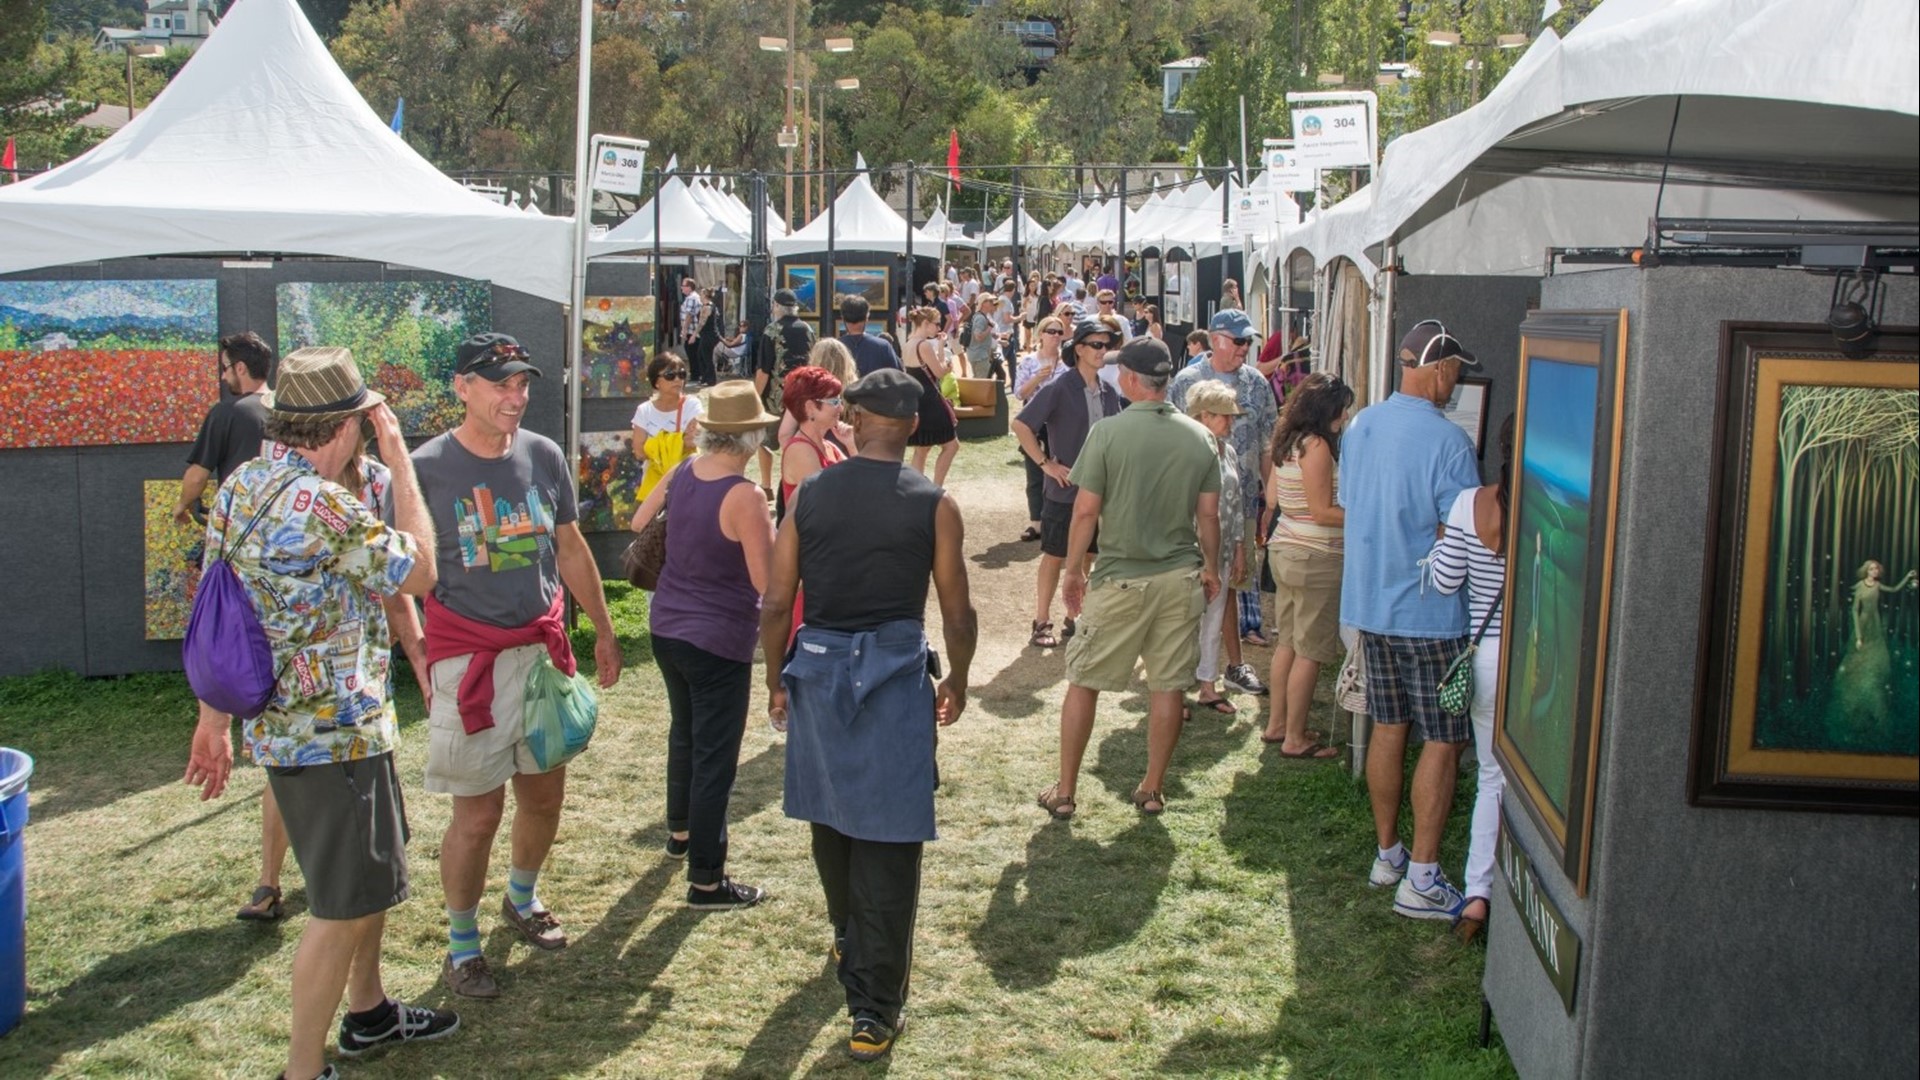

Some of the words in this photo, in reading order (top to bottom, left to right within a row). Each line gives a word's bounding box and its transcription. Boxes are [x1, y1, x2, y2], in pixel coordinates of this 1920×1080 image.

[1333, 117, 1356, 128] 304
[621, 158, 638, 168] 308
[295, 493, 308, 509] 66
[313, 503, 348, 533] TEXAS
[293, 655, 314, 696] TEXAS
